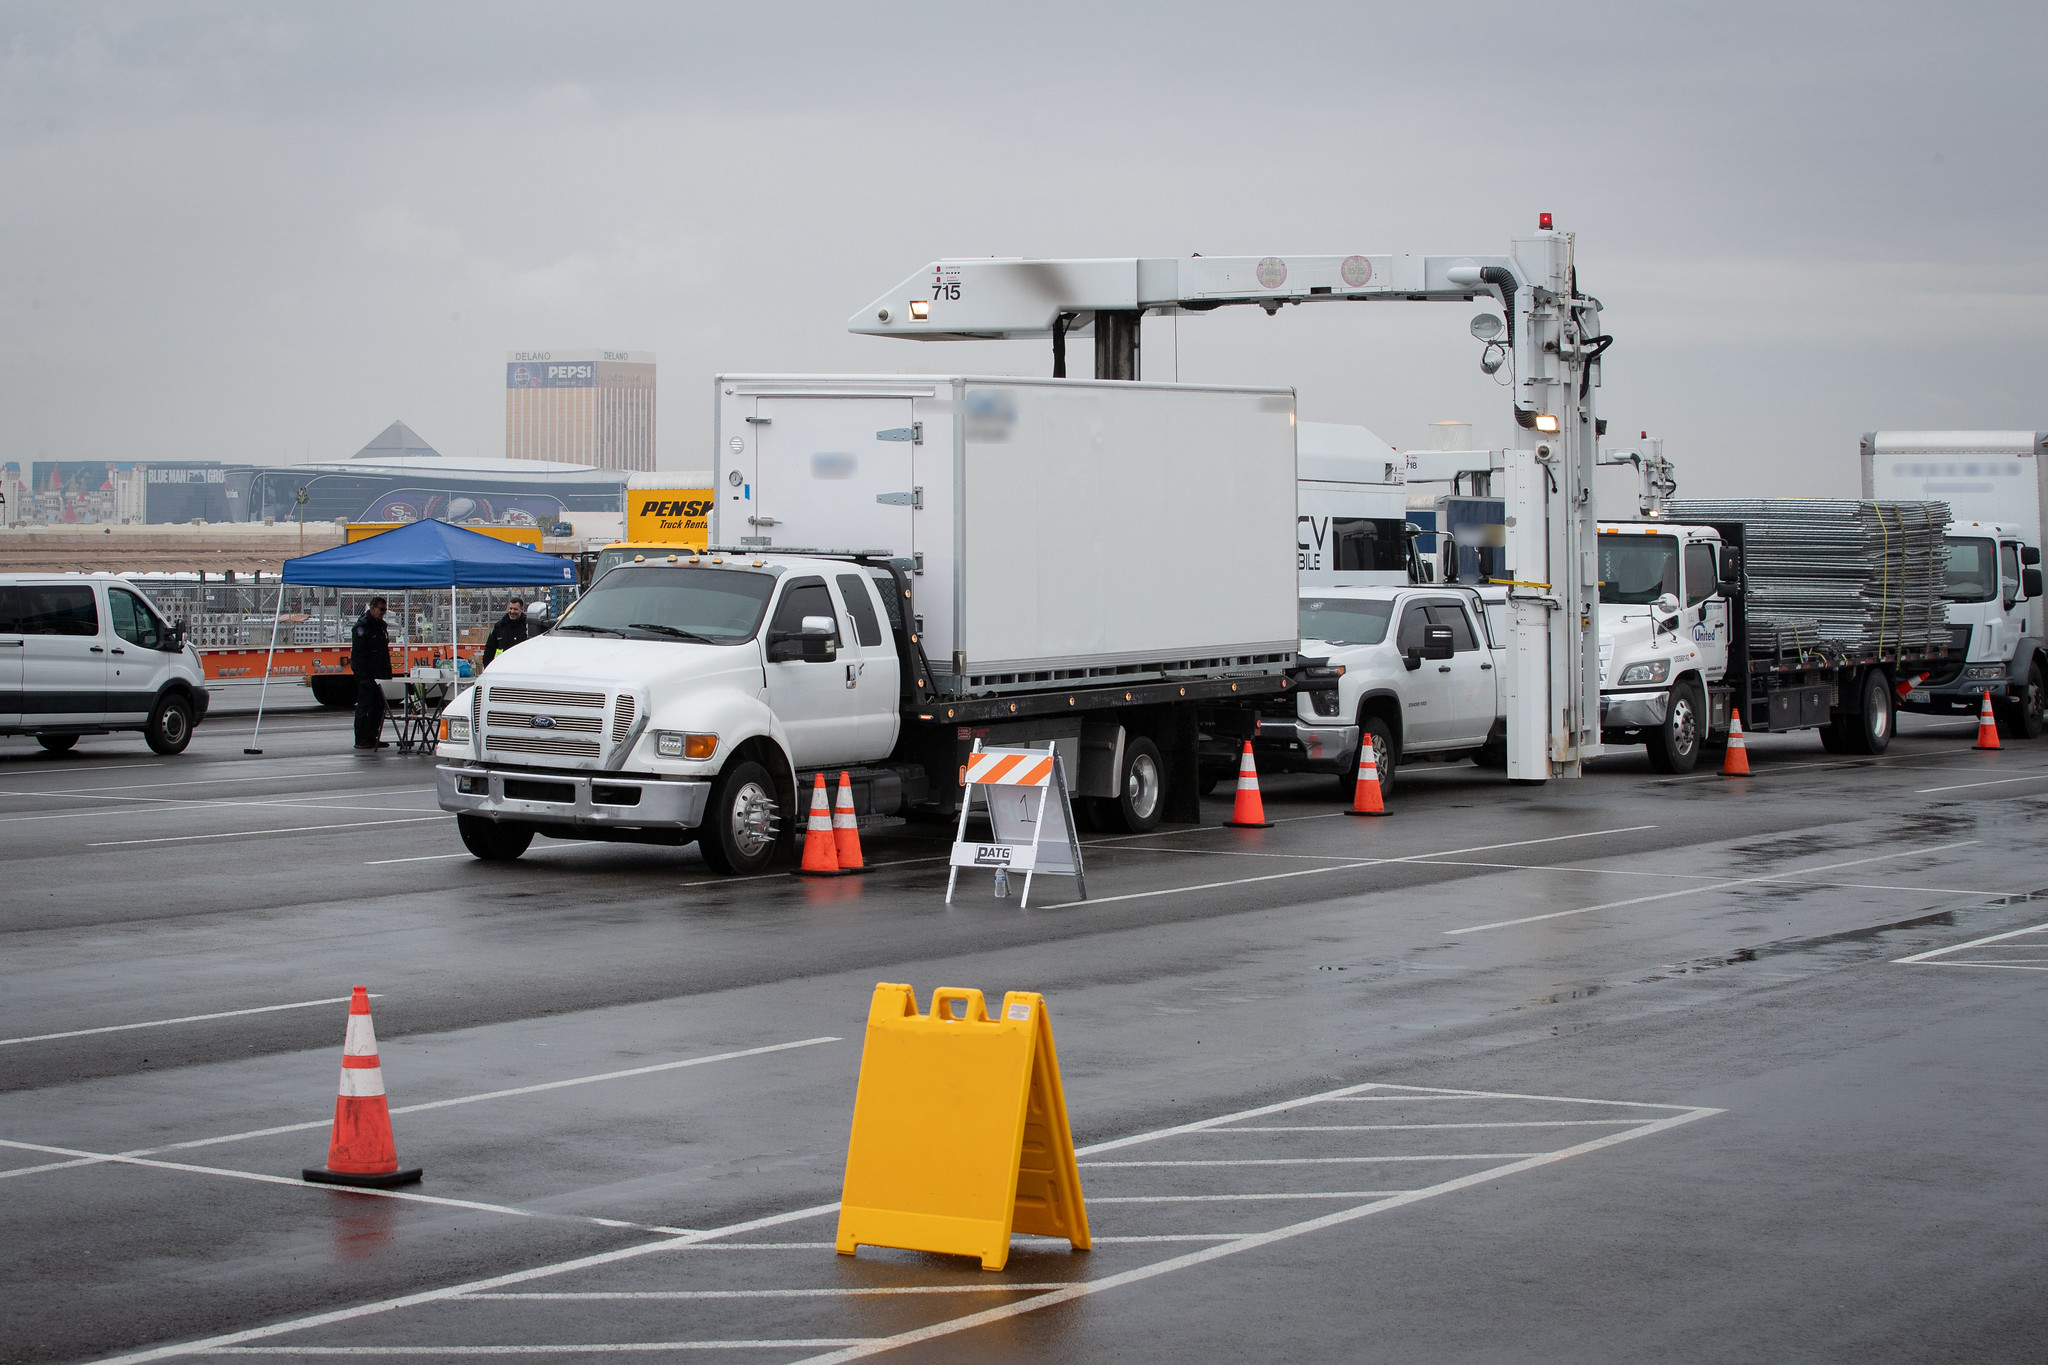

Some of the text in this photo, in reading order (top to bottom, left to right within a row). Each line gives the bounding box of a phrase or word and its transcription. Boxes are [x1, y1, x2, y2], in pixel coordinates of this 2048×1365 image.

[931, 285, 961, 301] 715
[515, 352, 551, 361] DELANO
[604, 352, 628, 360] DELANO
[548, 366, 591, 378] PEPSI
[1406, 461, 1418, 470] 718
[148, 470, 224, 483] BLUE MAN GRO
[640, 500, 714, 517] PENSK
[659, 519, 708, 529] Truck Renta
[1297, 515, 1329, 551] CV
[1298, 553, 1320, 570] BILE
[1695, 629, 1715, 641] United
[977, 847, 1010, 859] PATG
